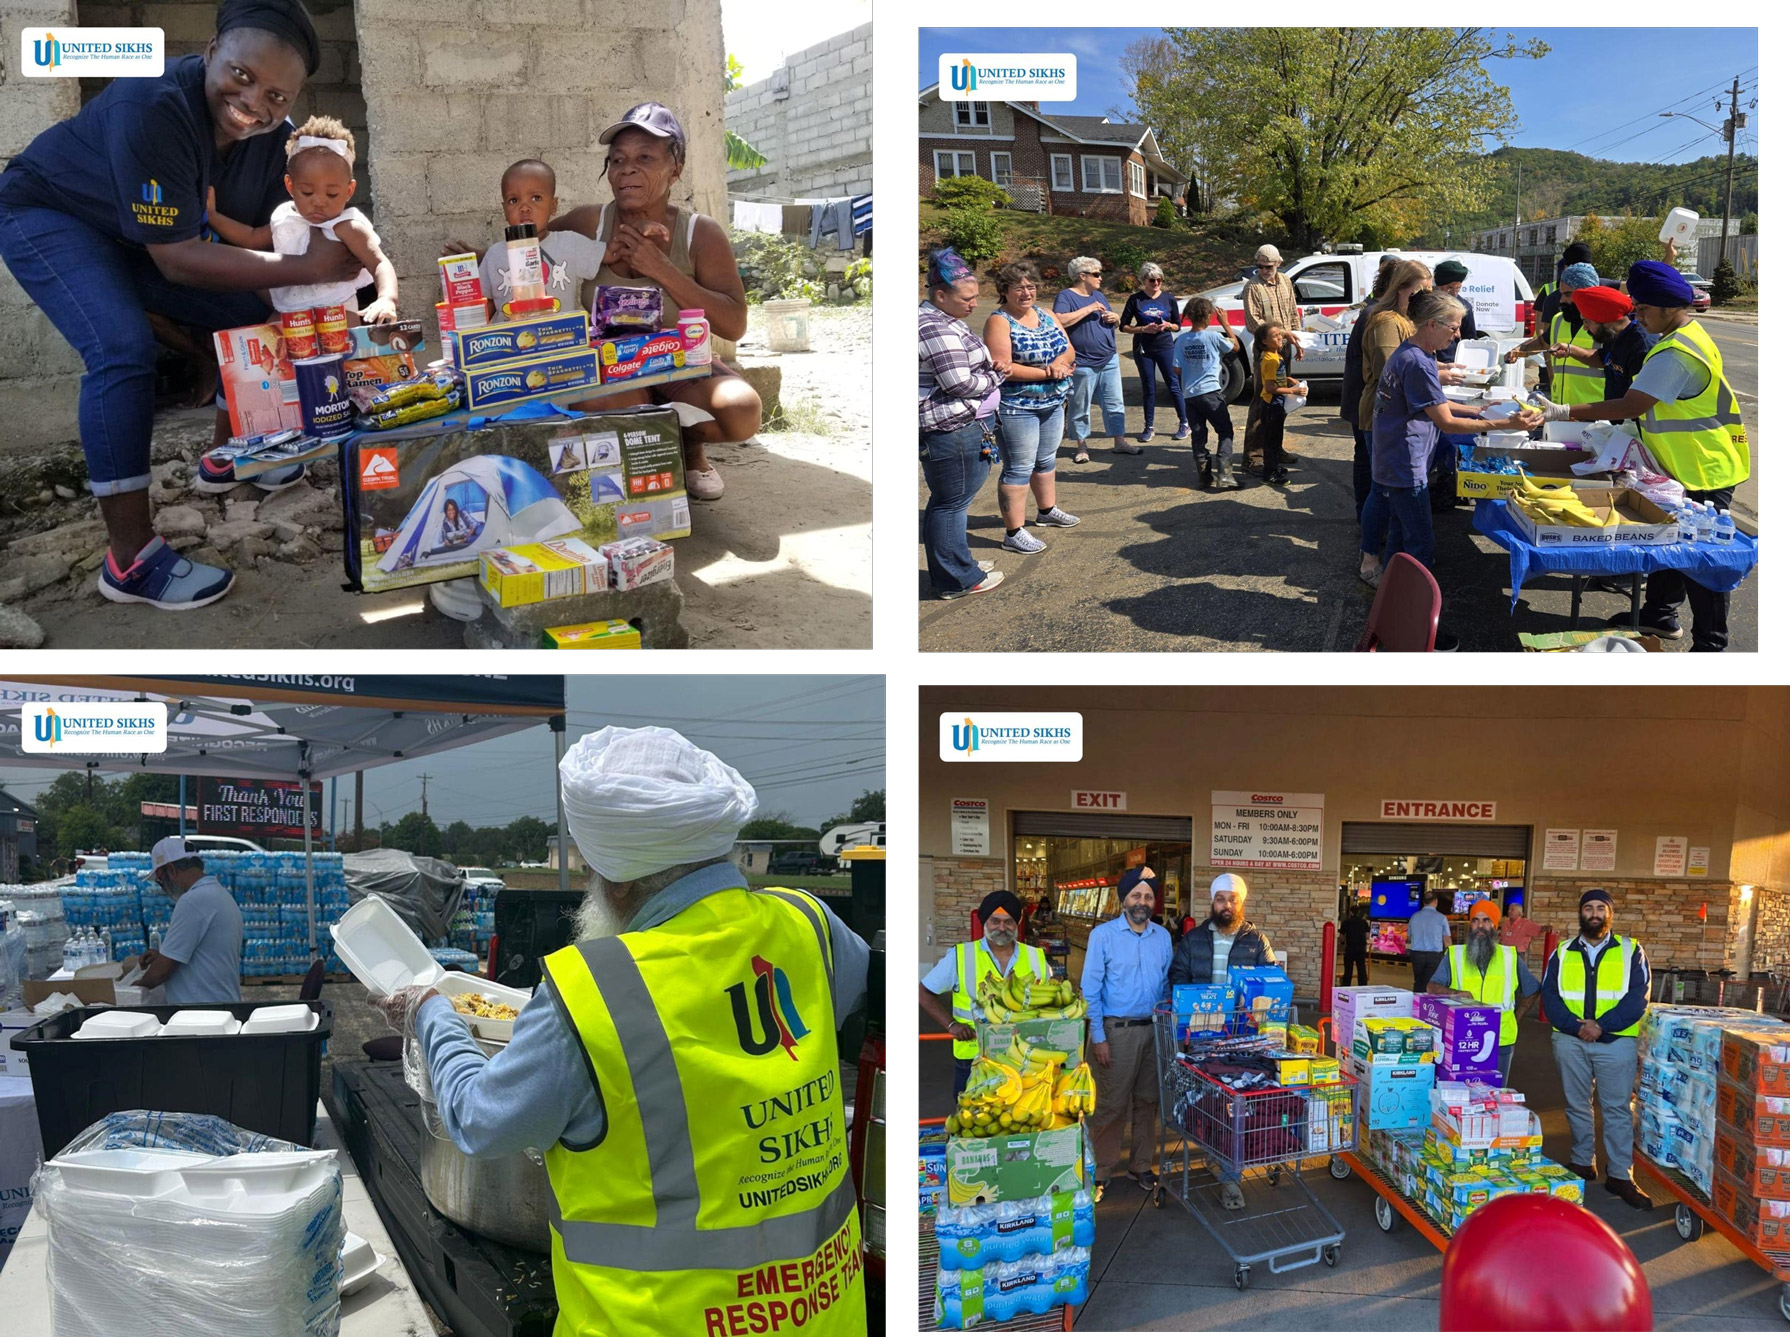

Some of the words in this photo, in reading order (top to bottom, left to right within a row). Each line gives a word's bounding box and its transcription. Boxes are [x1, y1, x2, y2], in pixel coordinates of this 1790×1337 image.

[132, 203, 178, 216] UNITED
[137, 214, 173, 226] SIKHS
[1469, 285, 1495, 293] Relief
[469, 337, 511, 354] RONZONI
[642, 340, 680, 356] Colgate
[607, 361, 641, 374] Colgate
[478, 376, 521, 395] RONZONI
[313, 413, 342, 424] IODIZED
[625, 437, 643, 446] DOME
[644, 434, 660, 443] TENT
[1463, 481, 1487, 490] NIDO
[1572, 534, 1612, 542] BAKED
[1614, 533, 1655, 541] BEANS
[639, 560, 672, 584] Energizer
[218, 785, 270, 805] Thank
[273, 788, 304, 807] You
[1076, 792, 1121, 807] EXIT
[204, 804, 238, 821] FIRST
[241, 806, 318, 827] RESPONDES
[1235, 809, 1275, 819] MEMBERS
[1277, 810, 1298, 819] ONLY
[1383, 802, 1493, 819] ENTRANCE
[1213, 821, 1231, 830] MON
[1237, 822, 1250, 830] FRI
[1259, 823, 1319, 833] 10:00AM-8:30PM
[1213, 835, 1253, 844] SATURDAY
[1262, 836, 1318, 846] 9:30AM-6:00PM
[1213, 848, 1243, 857] SUNDAY
[1258, 850, 1318, 859] 10:00AM-6:00PM
[1468, 1041, 1480, 1049] HR
[740, 1069, 834, 1130] UNITED
[738, 1169, 785, 1186] Recognize
[795, 1154, 825, 1169] Human
[927, 1163, 946, 1173] SUN
[999, 1217, 1035, 1230] KIRKLAND
[983, 1238, 1020, 1253] purified
[1022, 1235, 1049, 1244] water
[1001, 1275, 1036, 1288] KIRKLAND
[704, 1273, 840, 1337] RESPONSE
